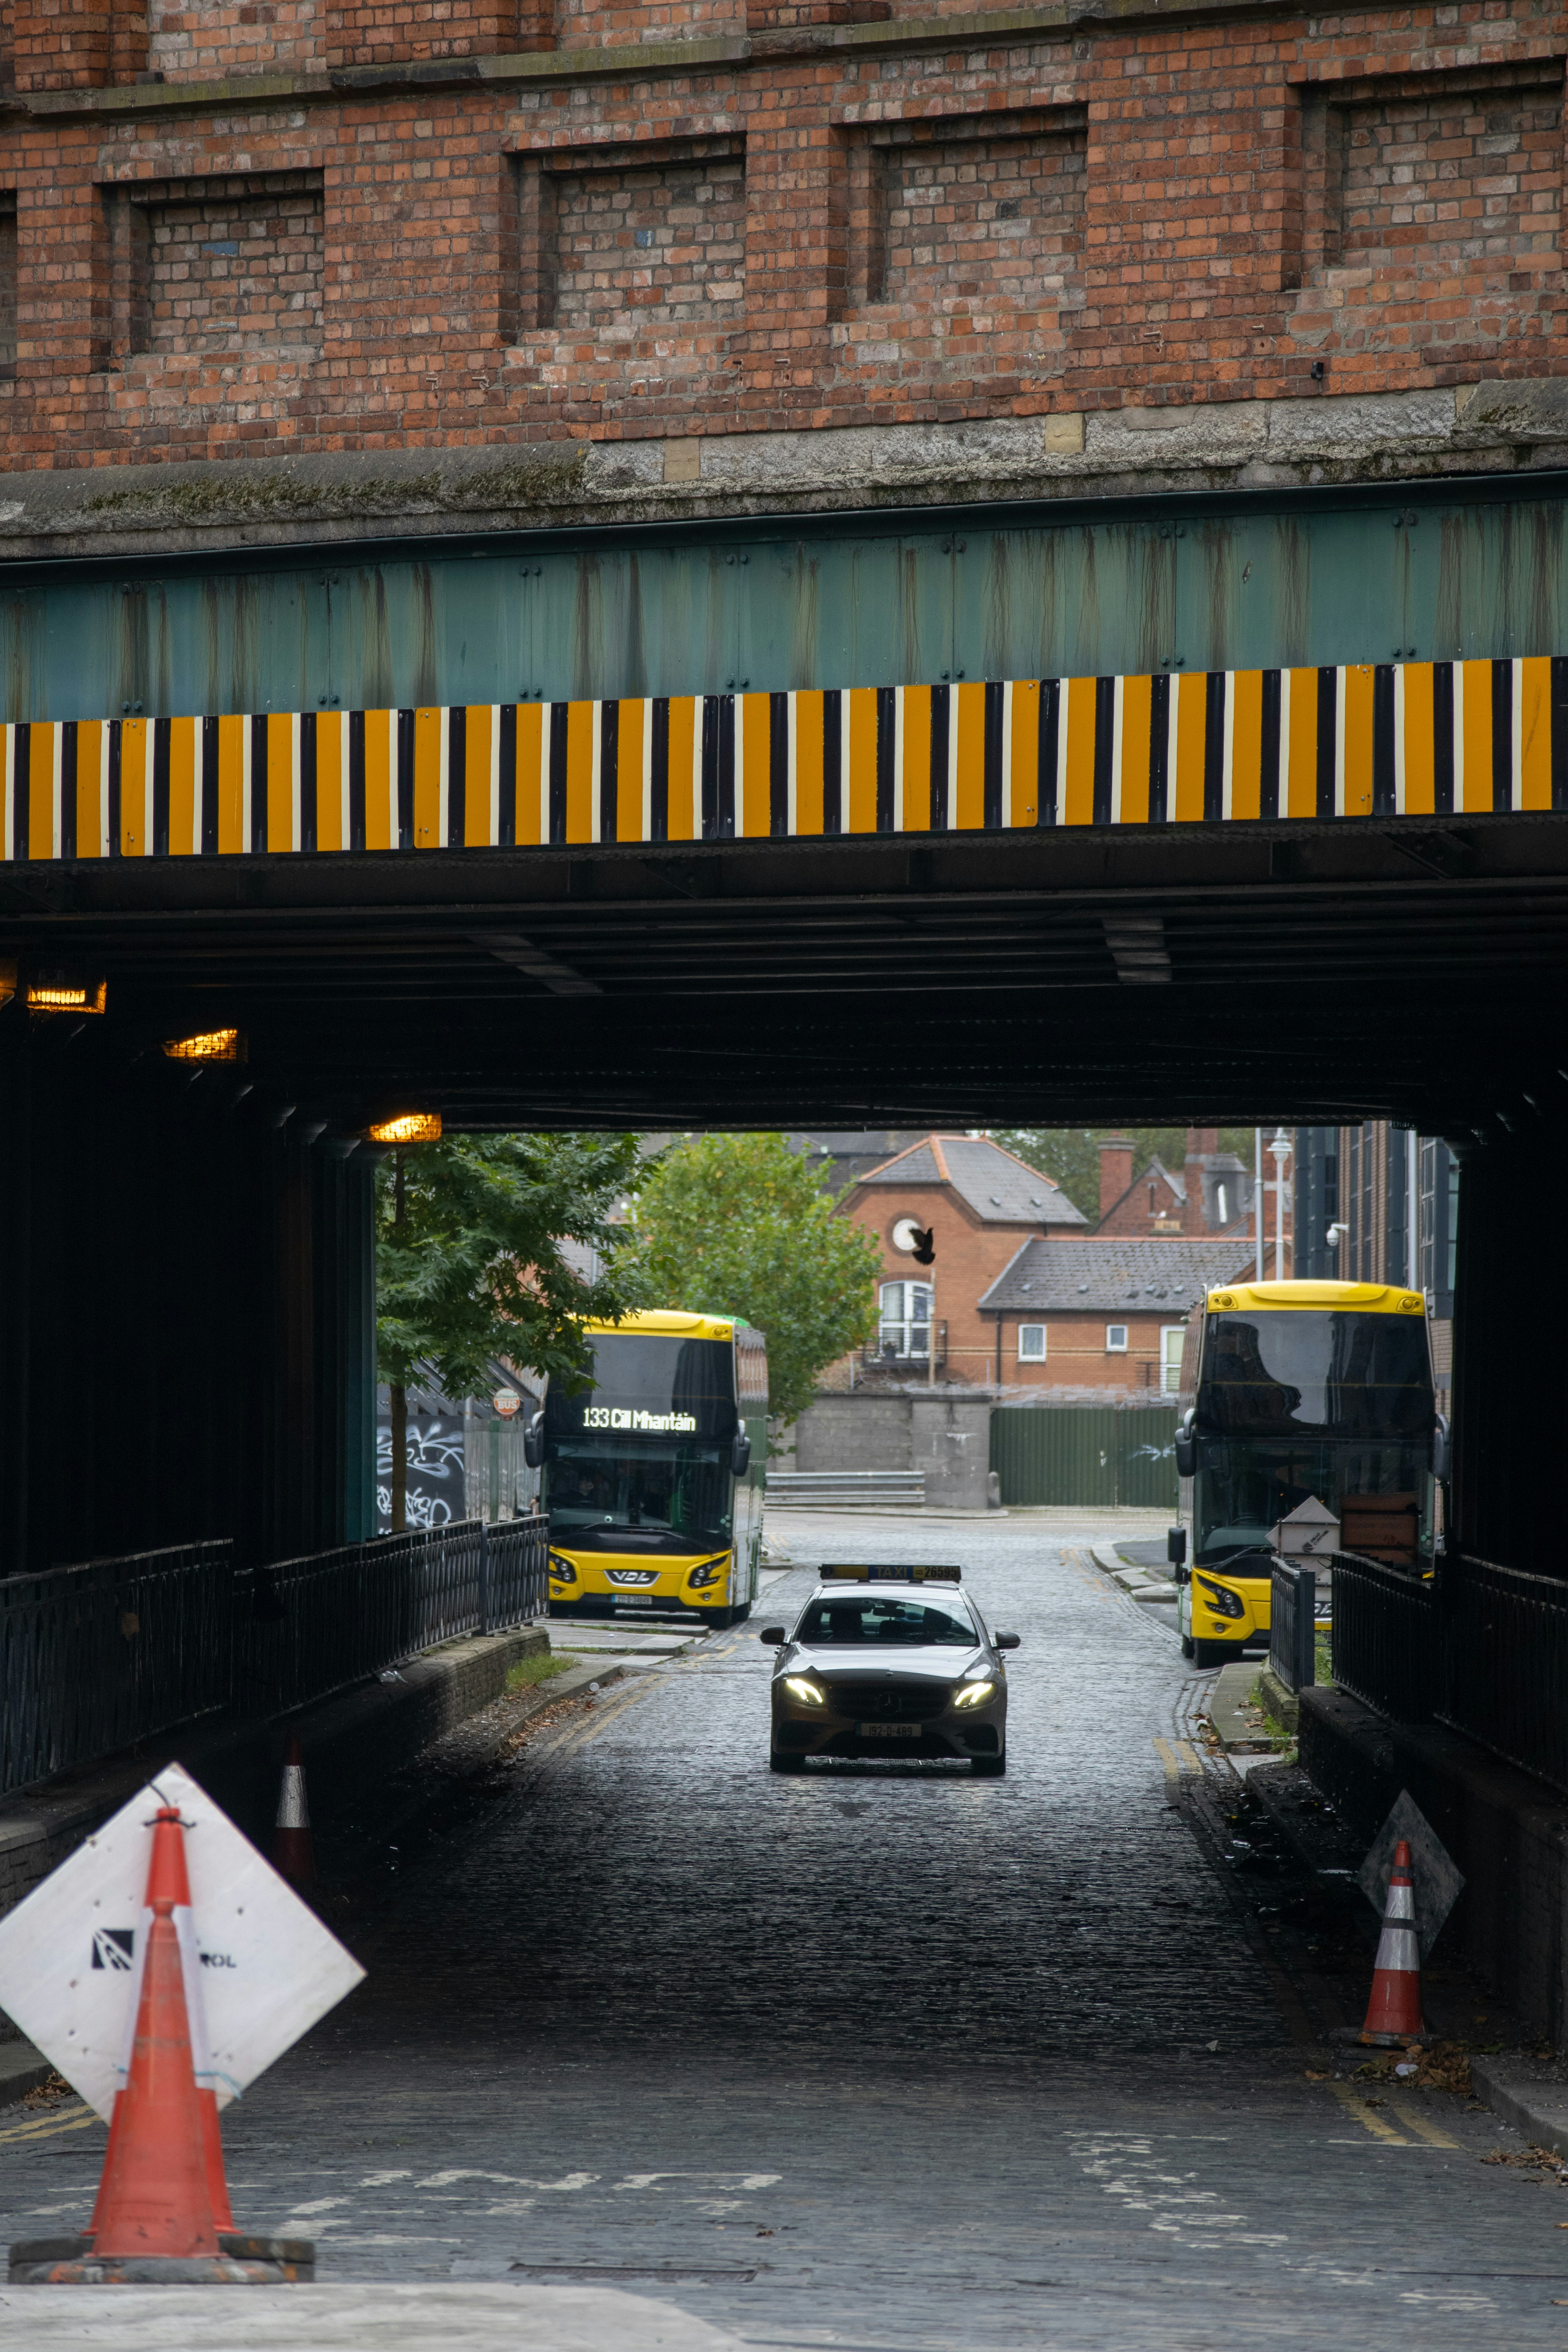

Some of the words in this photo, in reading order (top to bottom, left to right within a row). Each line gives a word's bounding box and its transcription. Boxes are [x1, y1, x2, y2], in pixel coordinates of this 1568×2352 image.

[498, 1400, 517, 1409] BUS
[583, 1407, 610, 1427] 133
[610, 1408, 632, 1428] Cill
[632, 1410, 696, 1431] Mhantáin
[612, 1571, 651, 1582] VDL
[876, 1566, 908, 1578] TAXI
[924, 1566, 957, 1579] 26595
